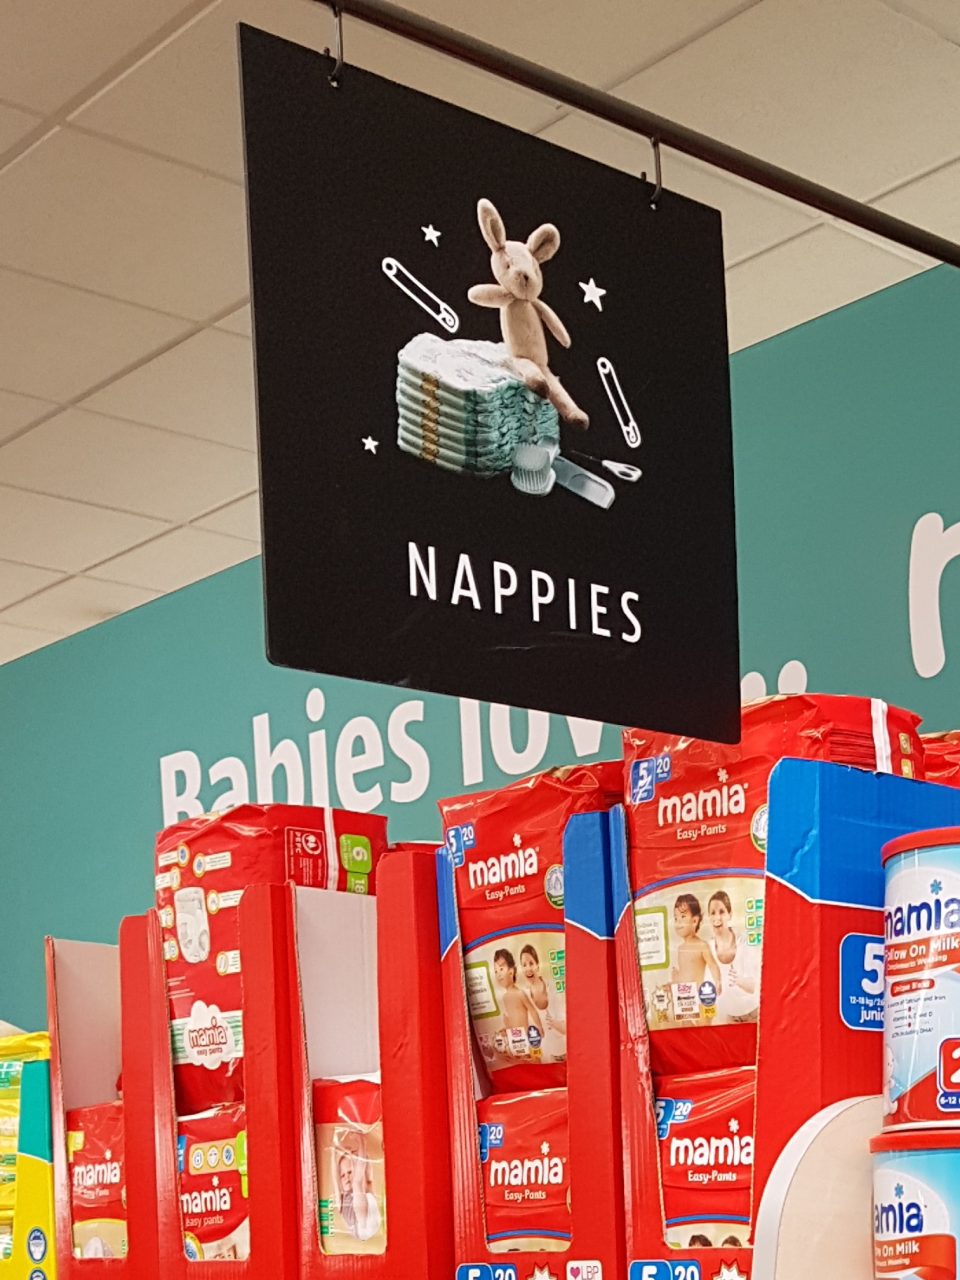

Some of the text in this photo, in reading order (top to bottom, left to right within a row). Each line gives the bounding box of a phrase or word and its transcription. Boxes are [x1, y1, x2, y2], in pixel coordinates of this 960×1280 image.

[408, 542, 642, 644] NAPPIES
[160, 688, 431, 831] Babies
[657, 768, 745, 826] mamia
[676, 824, 726, 840] Easy-Pants
[469, 833, 538, 889] mamia
[486, 884, 526, 900] Easy-Pants
[862, 943, 884, 994] 5
[74, 1149, 120, 1185] mamia
[490, 1142, 564, 1187] mamia
